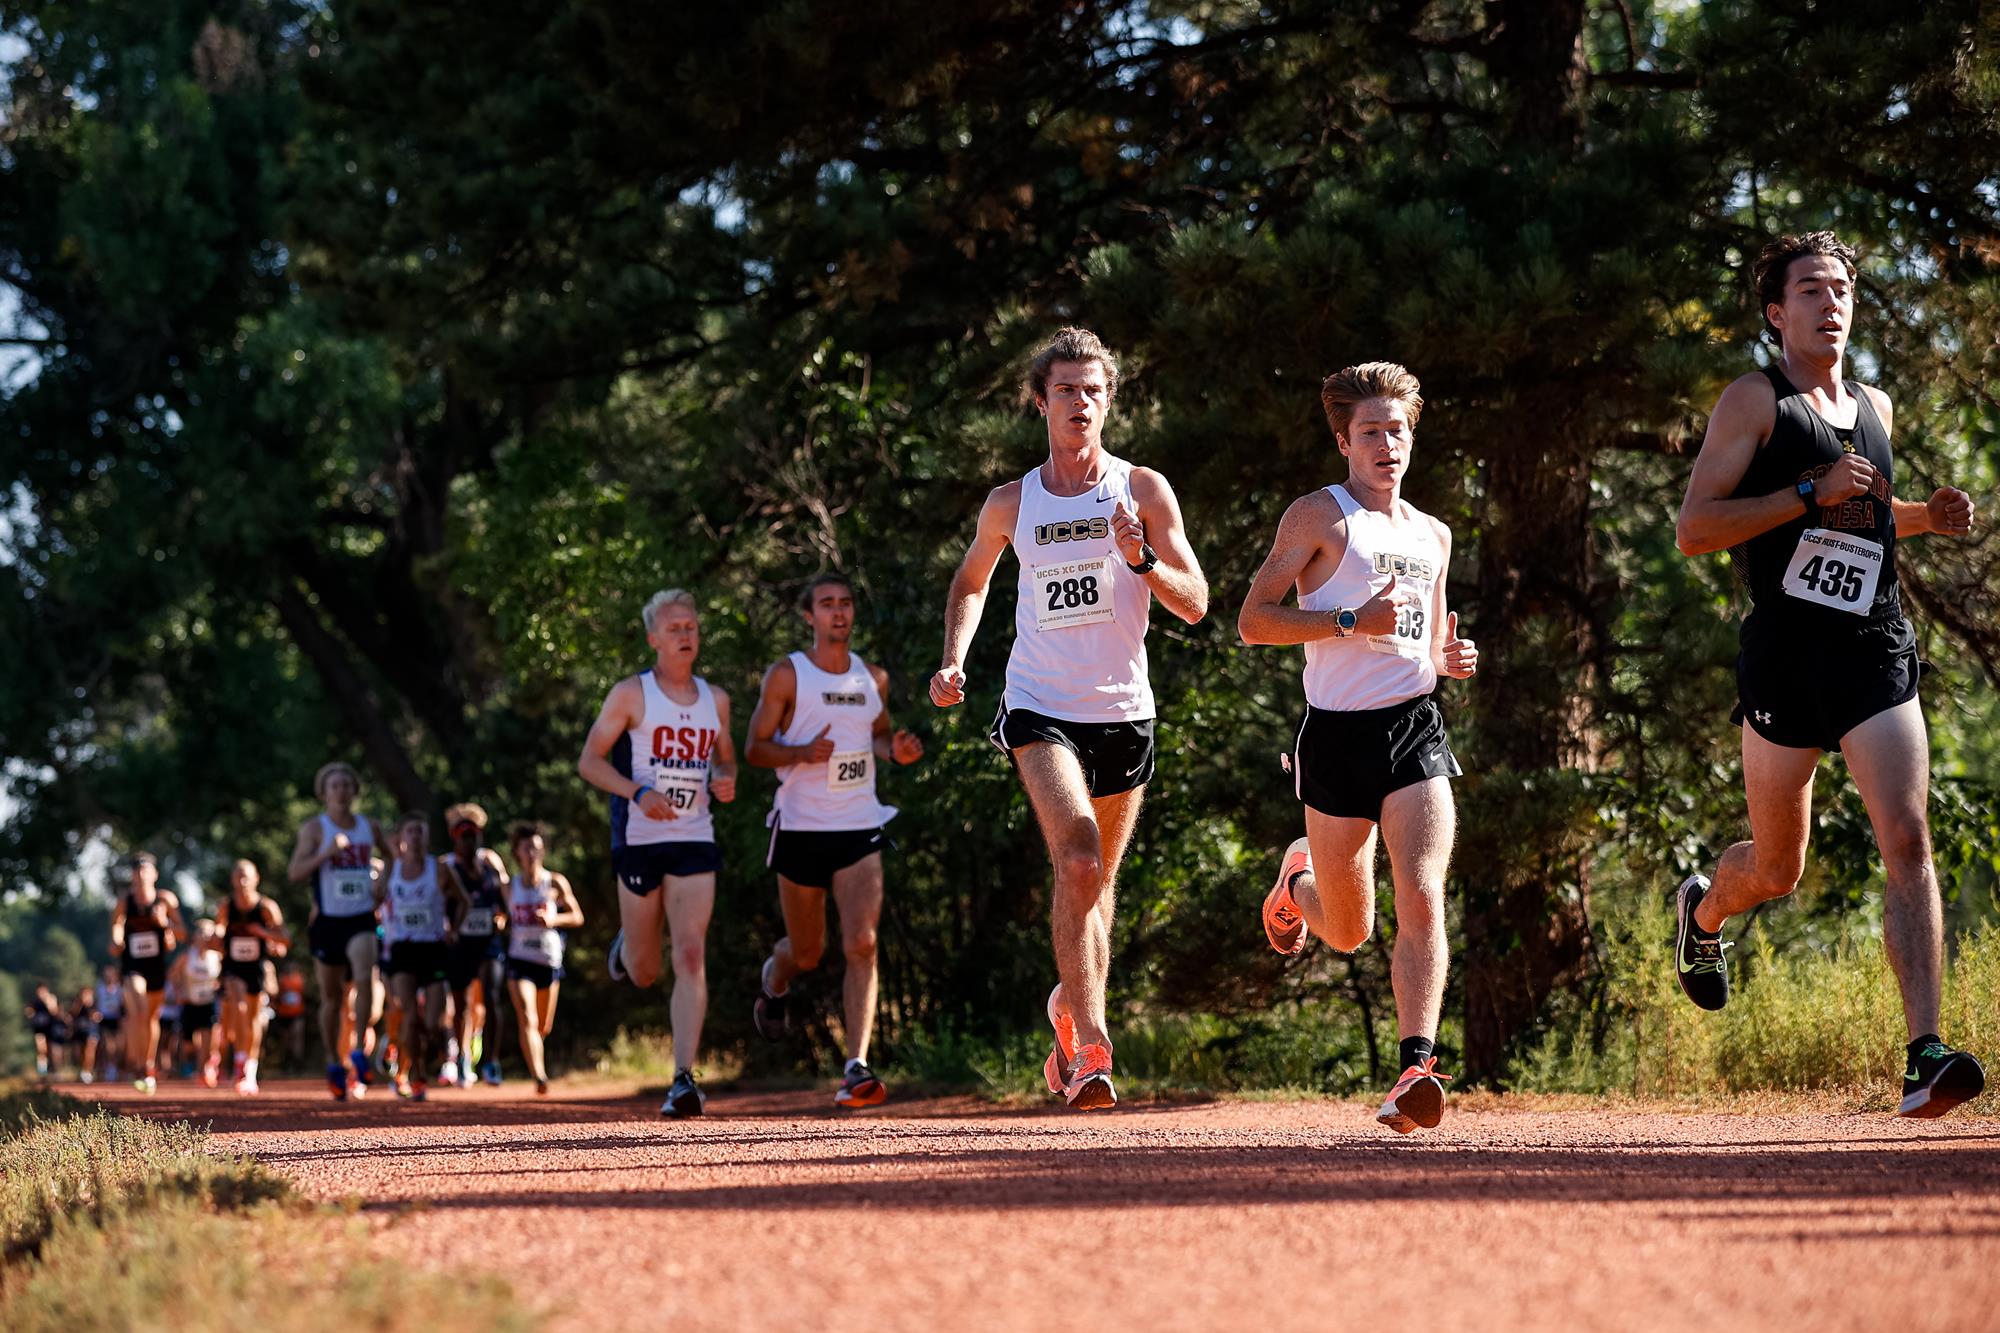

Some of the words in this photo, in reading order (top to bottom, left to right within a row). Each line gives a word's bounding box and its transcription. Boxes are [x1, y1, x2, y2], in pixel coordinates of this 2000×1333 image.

[1821, 500, 1875, 529] MESA
[1035, 517, 1109, 546] UCCS
[1803, 534, 1822, 546] UCCS
[1036, 568, 1060, 579] UCCS
[1062, 566, 1075, 574] XC
[1077, 561, 1104, 572] OPEN
[1373, 552, 1432, 582] UCCS
[1798, 555, 1867, 603] 435
[1046, 576, 1099, 611] 288
[1397, 609, 1425, 640] 93
[652, 725, 715, 760] CSU
[838, 759, 866, 781] 290
[665, 787, 696, 809] 457
